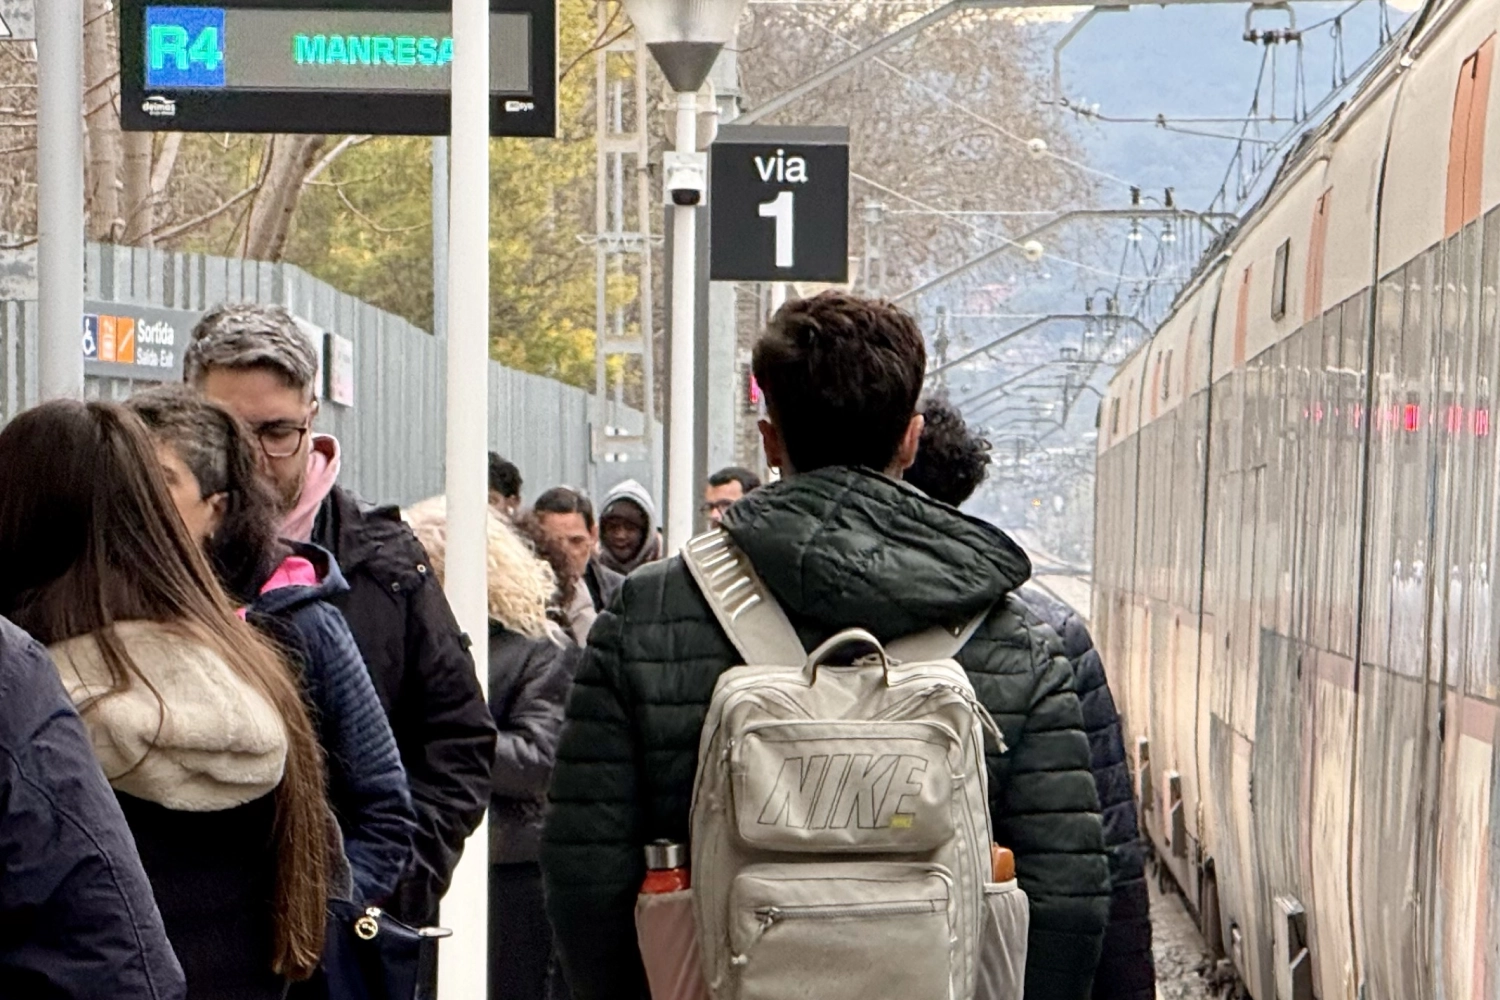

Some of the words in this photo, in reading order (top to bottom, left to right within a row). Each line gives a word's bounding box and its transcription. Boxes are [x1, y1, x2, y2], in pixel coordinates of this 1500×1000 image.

[149, 24, 223, 71] R4
[293, 34, 454, 66] MANRESA
[754, 148, 809, 183] via
[758, 190, 794, 268] 1
[137, 318, 174, 346] Sortida
[757, 753, 929, 830] NIKE
